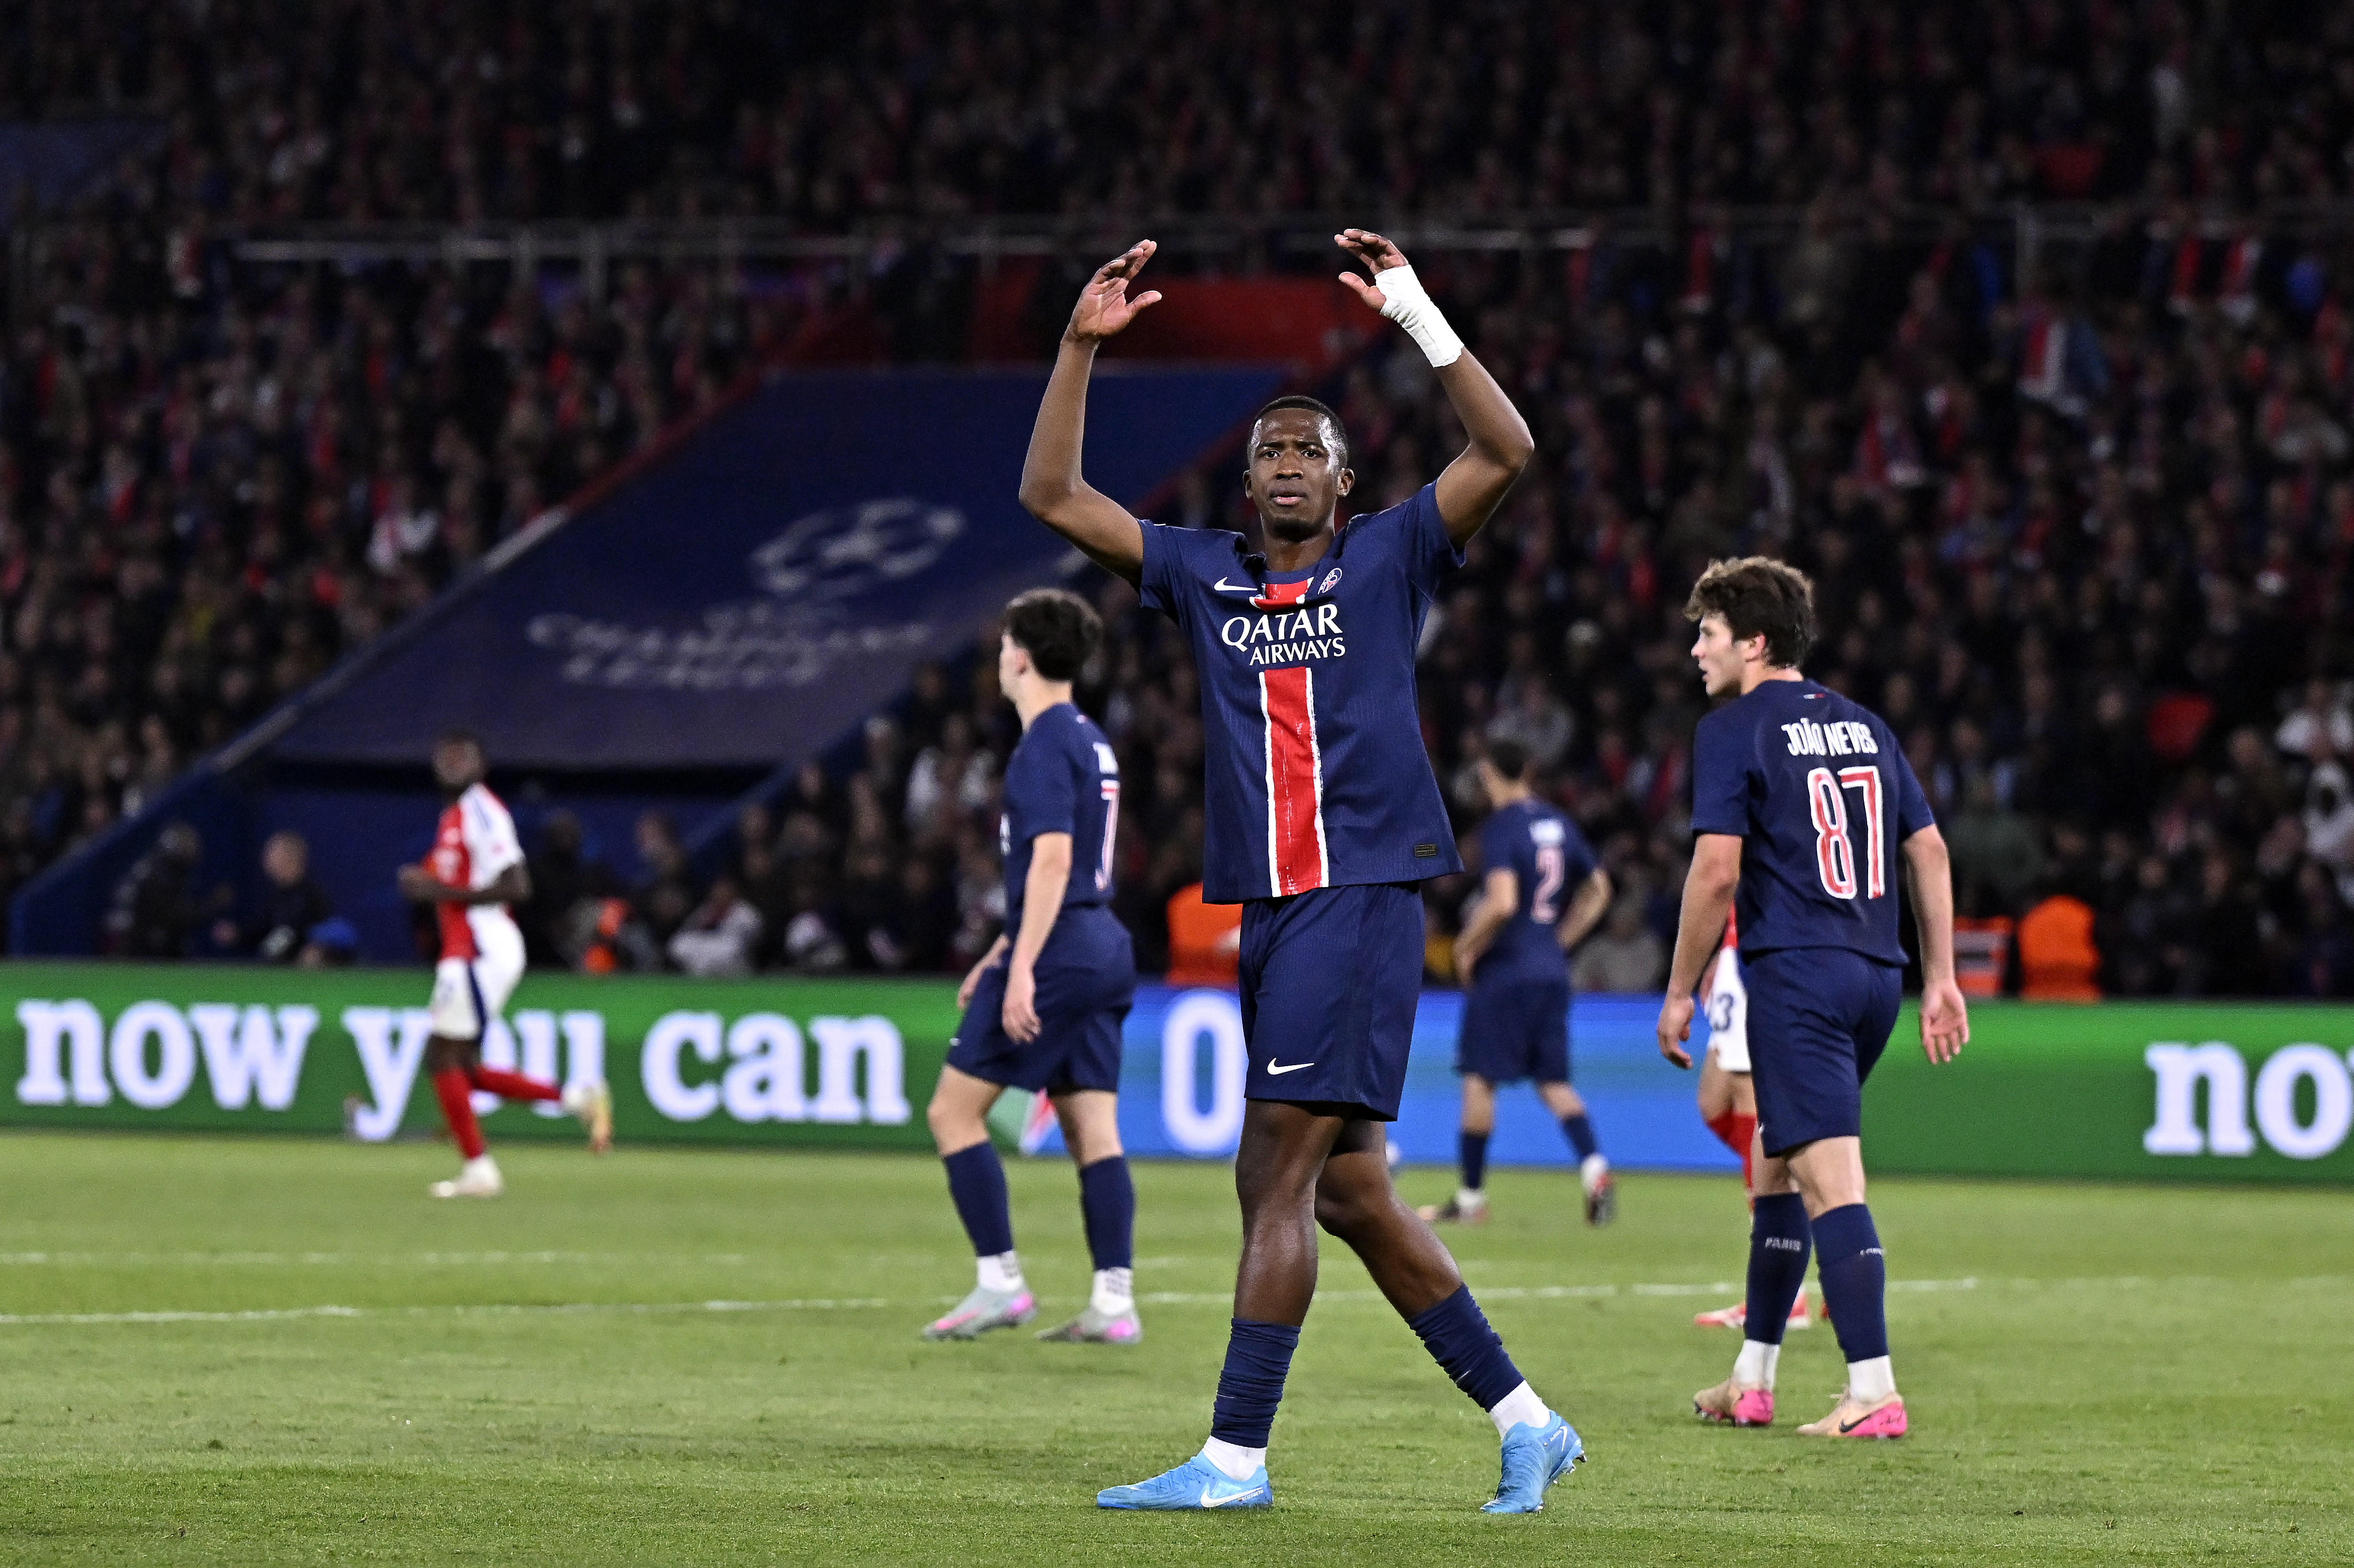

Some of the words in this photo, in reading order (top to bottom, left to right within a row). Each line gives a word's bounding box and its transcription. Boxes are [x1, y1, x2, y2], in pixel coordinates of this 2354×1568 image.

[1222, 604, 1343, 652] QATAR
[1249, 637, 1346, 666] AIRWAYS
[1781, 717, 1827, 756] JOÃO
[1823, 721, 1879, 757] NEVES
[1094, 779, 1120, 890] 7
[1807, 766, 1885, 899] 87
[1530, 847, 1565, 924] 2
[16, 998, 320, 1110] now
[640, 1009, 911, 1125] can
[2143, 1041, 2354, 1160] no
